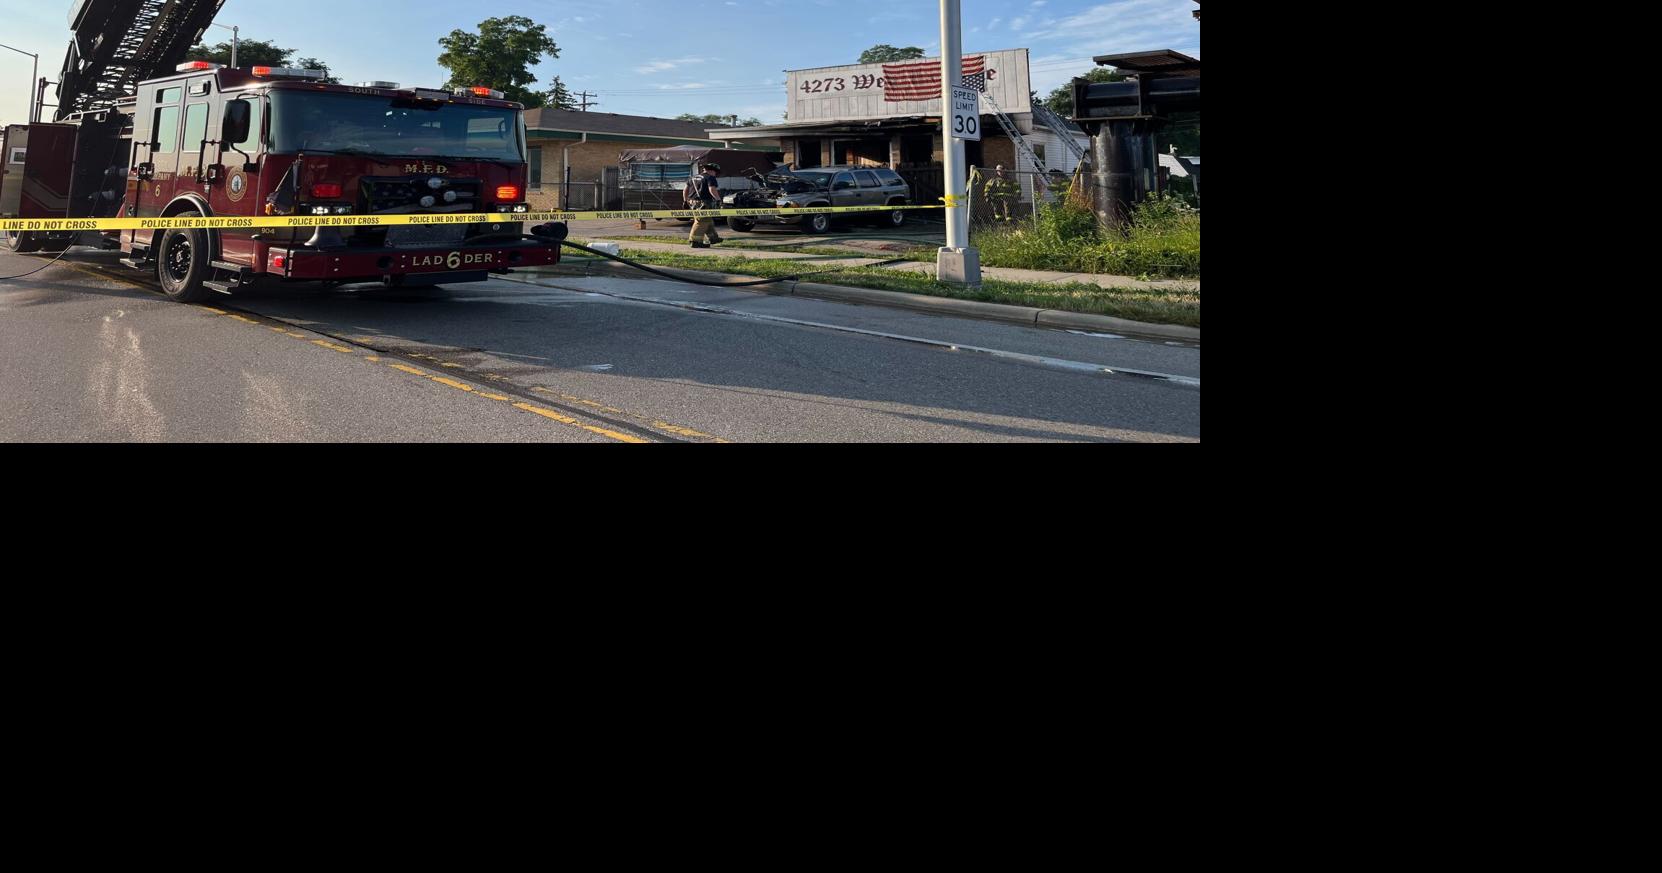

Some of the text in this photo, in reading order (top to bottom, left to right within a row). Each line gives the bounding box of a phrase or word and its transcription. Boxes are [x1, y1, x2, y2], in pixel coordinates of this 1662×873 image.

[800, 77, 845, 93] 4273
[348, 86, 380, 95] SOUTH
[953, 90, 976, 101] SPEED
[955, 102, 974, 111] LIMIT
[954, 115, 976, 134] 30
[3, 220, 98, 230] LINE DO NOT CROSS
[141, 218, 253, 227] POLICE LINE DO NOT CROSS
[288, 217, 313, 225] POLICE
[314, 217, 330, 225] LINE
[331, 217, 341, 225] DO
[412, 251, 493, 269] LAD 6 DER
